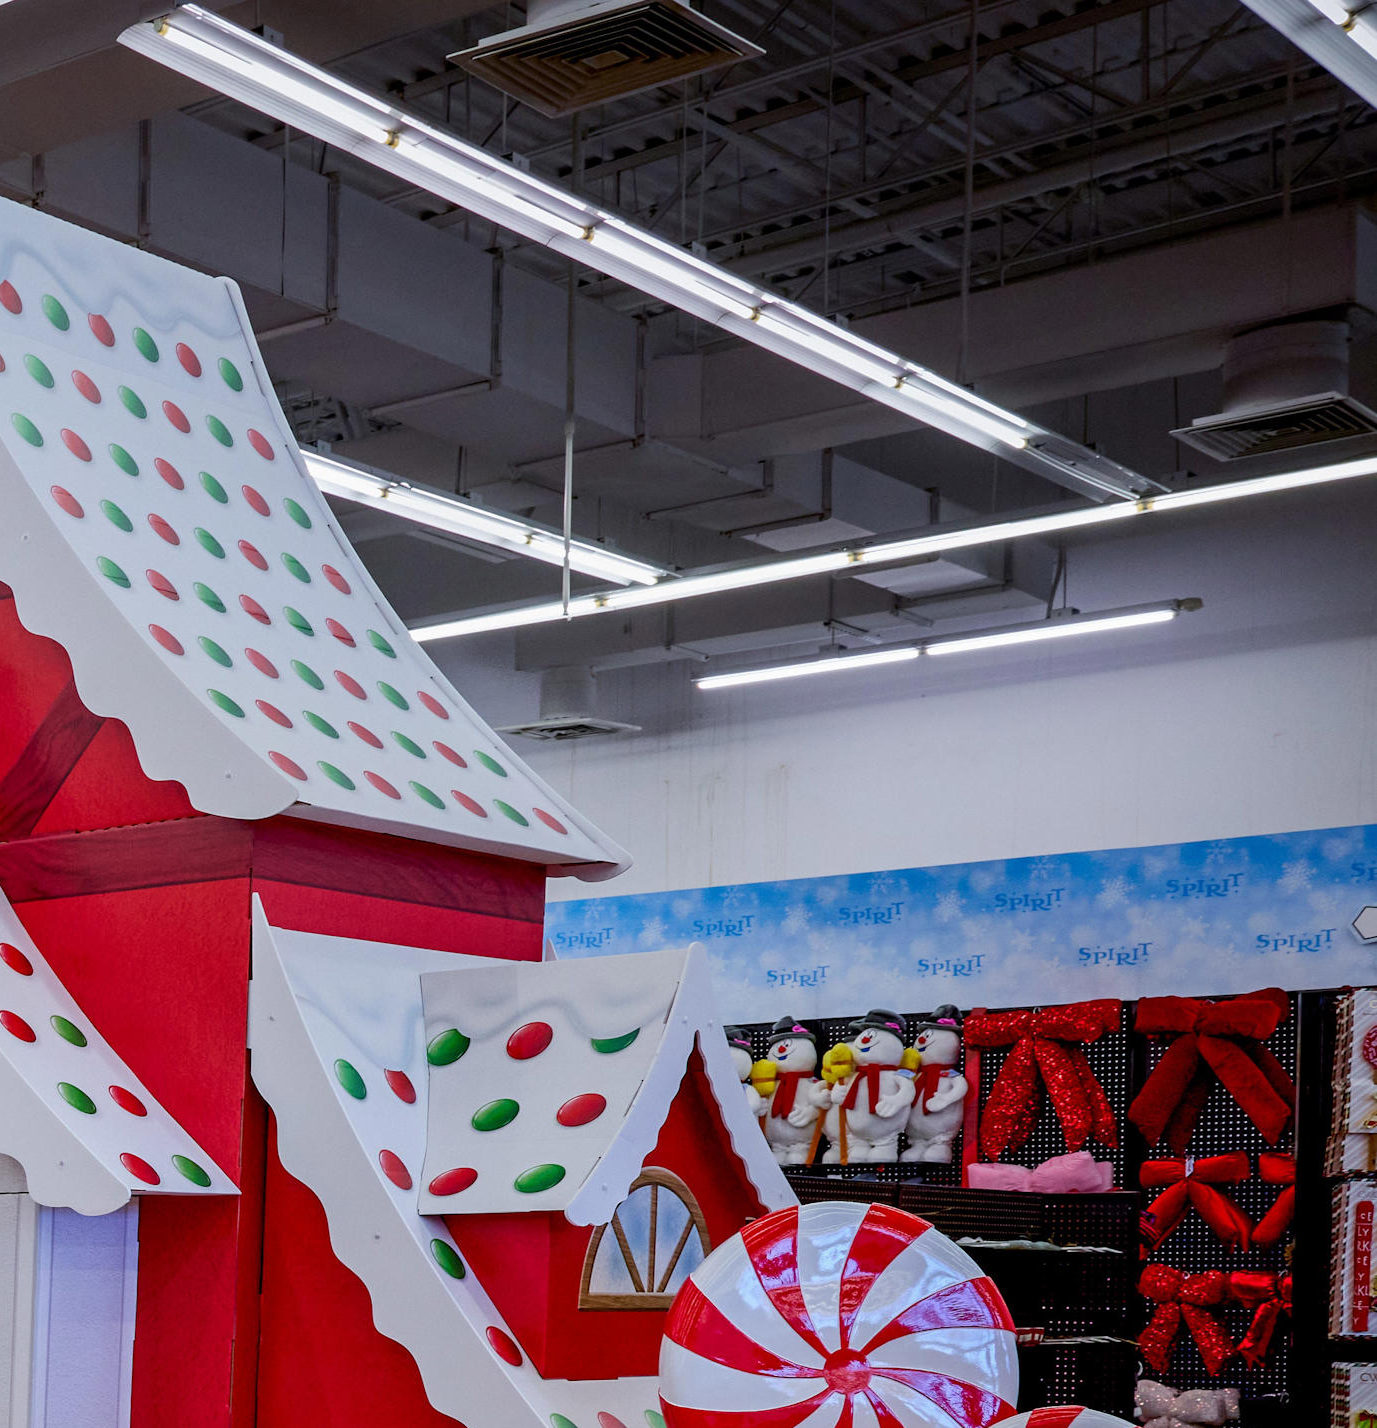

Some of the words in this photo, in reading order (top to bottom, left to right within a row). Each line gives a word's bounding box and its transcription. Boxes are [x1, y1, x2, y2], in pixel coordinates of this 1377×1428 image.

[1165, 873, 1244, 899] SPIRIT
[994, 888, 1066, 913] SPIRIT
[838, 902, 904, 926] SPIRIT
[556, 927, 615, 949] SPIRIT
[693, 915, 755, 938] SPIRIT
[1256, 928, 1337, 954] SPIRIT
[917, 954, 986, 978] SPIRIT
[1078, 942, 1153, 967] SPIRIT
[766, 965, 831, 989] SPIRIT
